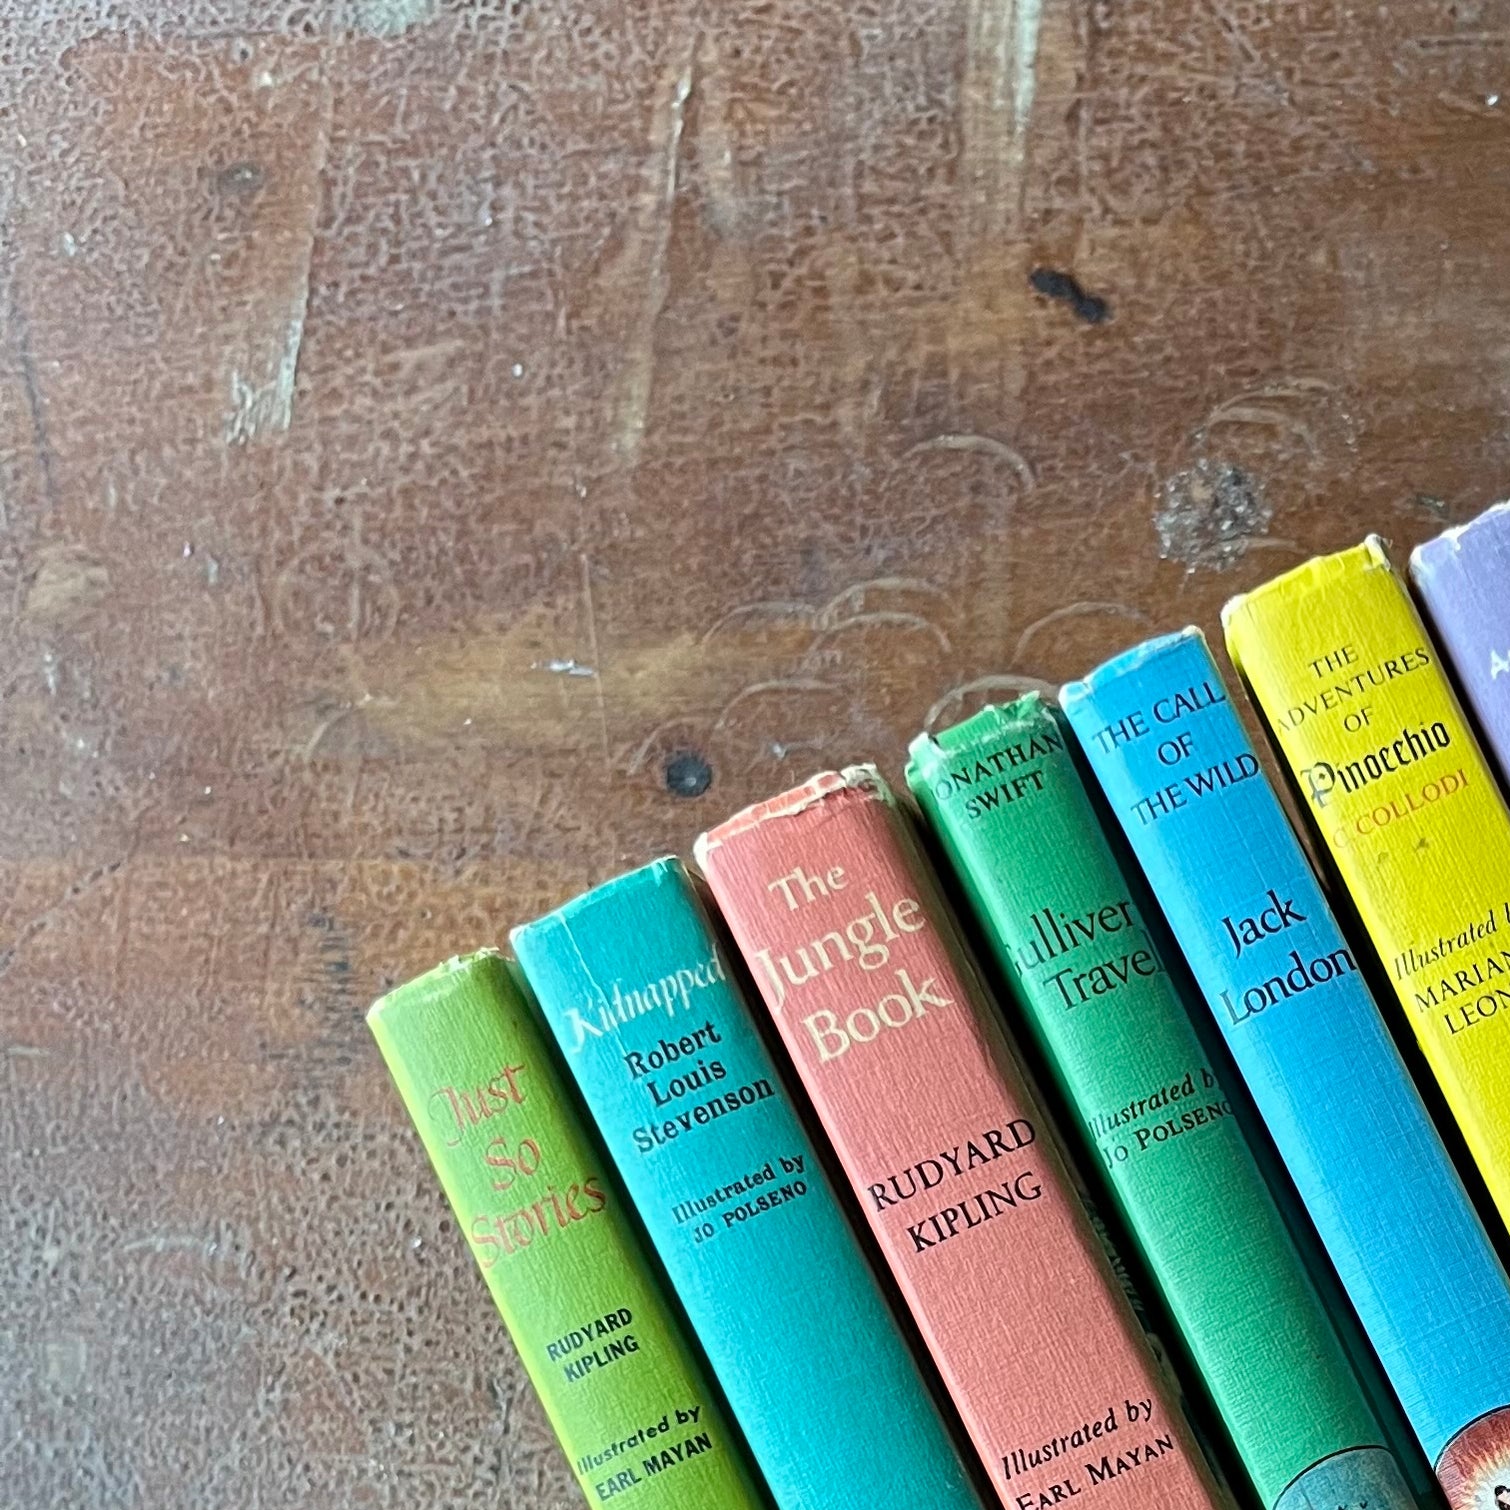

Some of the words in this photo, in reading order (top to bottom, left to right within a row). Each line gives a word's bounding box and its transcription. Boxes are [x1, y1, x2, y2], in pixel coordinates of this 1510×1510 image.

[1308, 644, 1359, 678] THE
[1093, 711, 1149, 753] THE
[1153, 682, 1226, 724] CALL
[1158, 732, 1194, 765] OF
[1344, 705, 1374, 733] OF
[932, 734, 1063, 800] ONATHAN
[965, 770, 1044, 819] SWIFT
[1131, 784, 1187, 826] THE
[1185, 753, 1259, 798] WILD
[1300, 721, 1450, 808] Pinocchio
[1356, 768, 1469, 835] COLLODI
[767, 865, 849, 911] The
[755, 891, 926, 1016] Jungle
[1005, 900, 1134, 977] ulliver
[1221, 889, 1307, 959] Jack
[1394, 914, 1497, 981] Illustrated
[563, 943, 726, 1055] Kidnapped
[801, 969, 955, 1063] Book
[1220, 948, 1357, 1025] London
[623, 1020, 721, 1080] Robert
[647, 1060, 727, 1107] Louis
[1201, 1068, 1218, 1089] b
[428, 1063, 526, 1147] Just
[632, 1078, 776, 1153] Stevenson
[485, 1136, 540, 1192] So
[672, 1163, 775, 1224] Illustrated
[779, 1155, 805, 1175] by
[867, 1118, 1036, 1212] RUDYARD
[471, 1177, 606, 1268] Stories
[694, 1222, 714, 1243] JO
[721, 1180, 807, 1228] POLSENO
[905, 1171, 1042, 1253] KIPLING
[545, 1308, 633, 1362] RUDYARD
[563, 1335, 640, 1382] KIPLING
[577, 1416, 669, 1475] Illustrated
[675, 1406, 700, 1424] by
[596, 1468, 642, 1501] EARL
[642, 1432, 712, 1477] MAYAN
[1001, 1407, 1117, 1480] Illustrated
[1126, 1398, 1153, 1424] by
